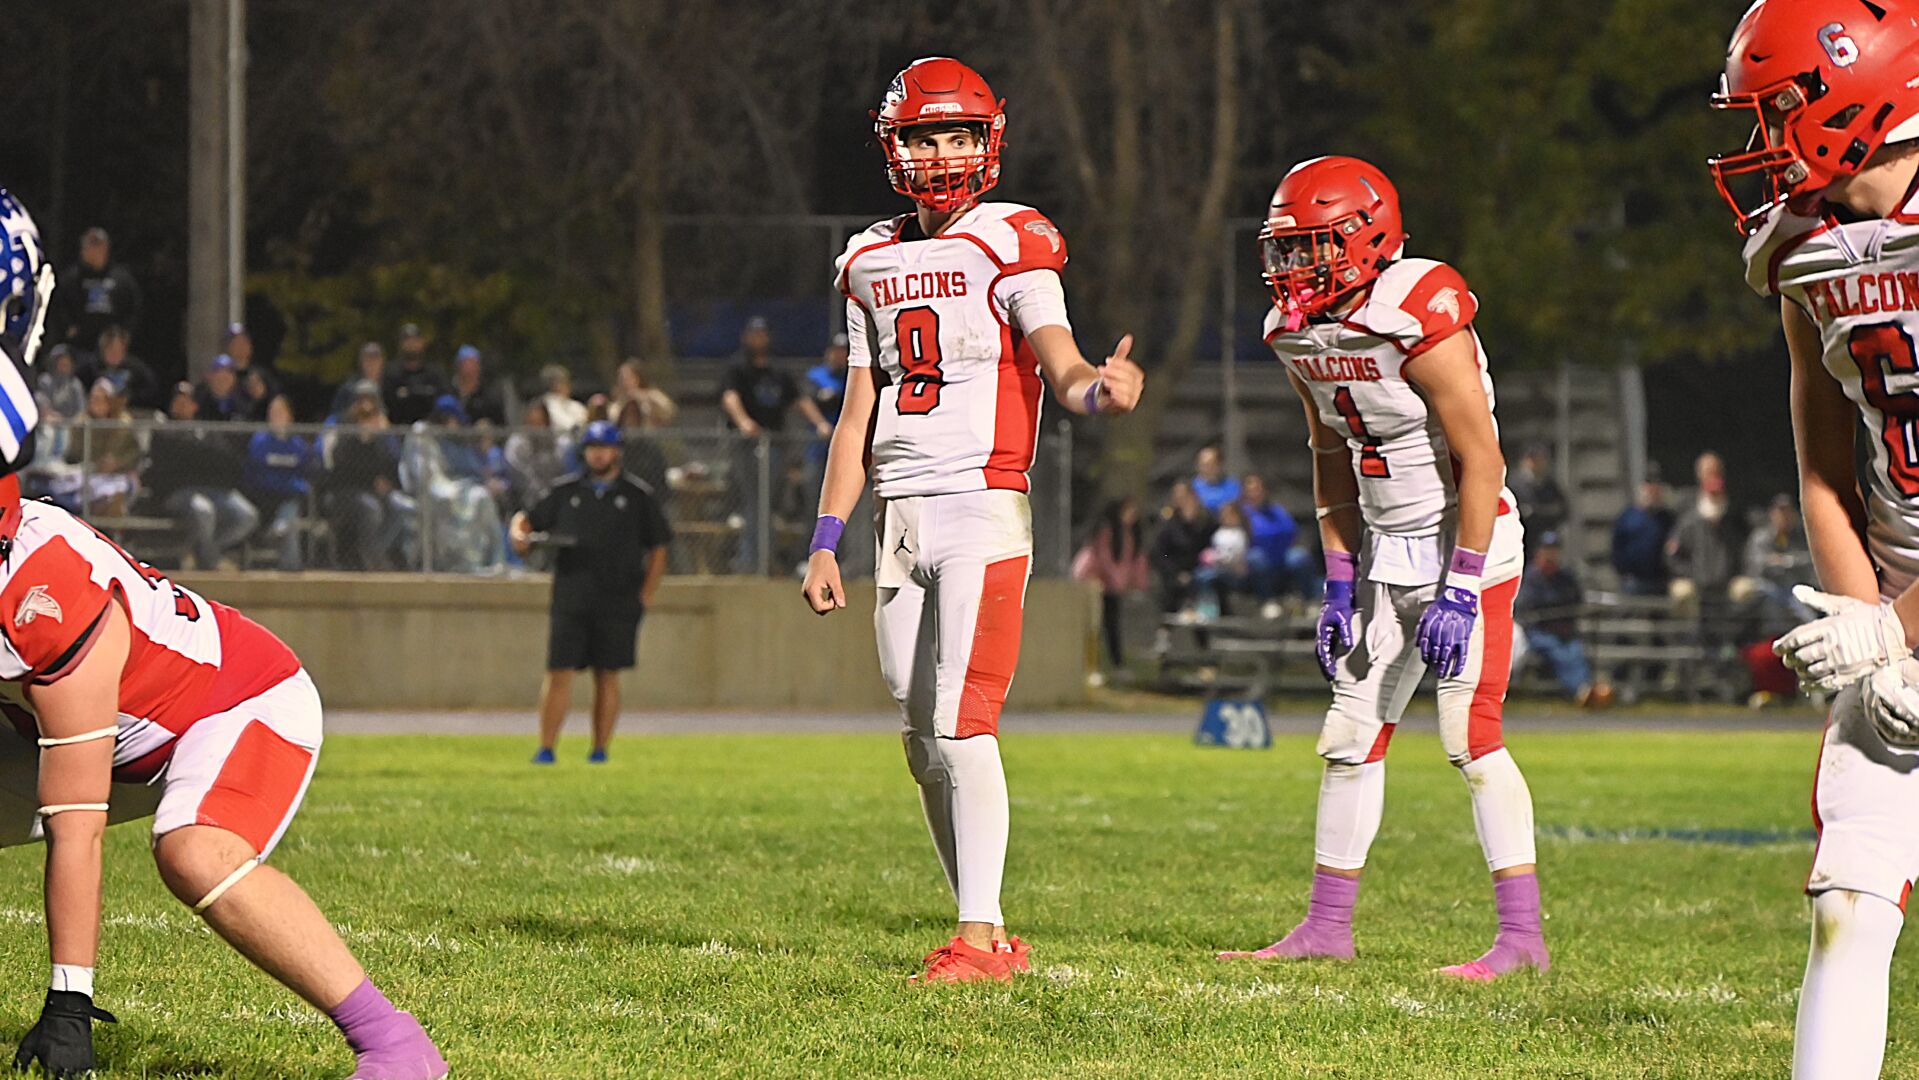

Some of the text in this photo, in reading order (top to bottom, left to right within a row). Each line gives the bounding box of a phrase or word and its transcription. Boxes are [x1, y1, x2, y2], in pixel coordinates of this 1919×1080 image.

[1817, 21, 1860, 67] 6
[870, 271, 968, 309] FALCONS
[894, 305, 944, 415] 8
[1292, 355, 1383, 382] FALCONS
[1333, 385, 1391, 478] 1
[1847, 319, 1919, 499] 6
[1219, 703, 1264, 748] 30
